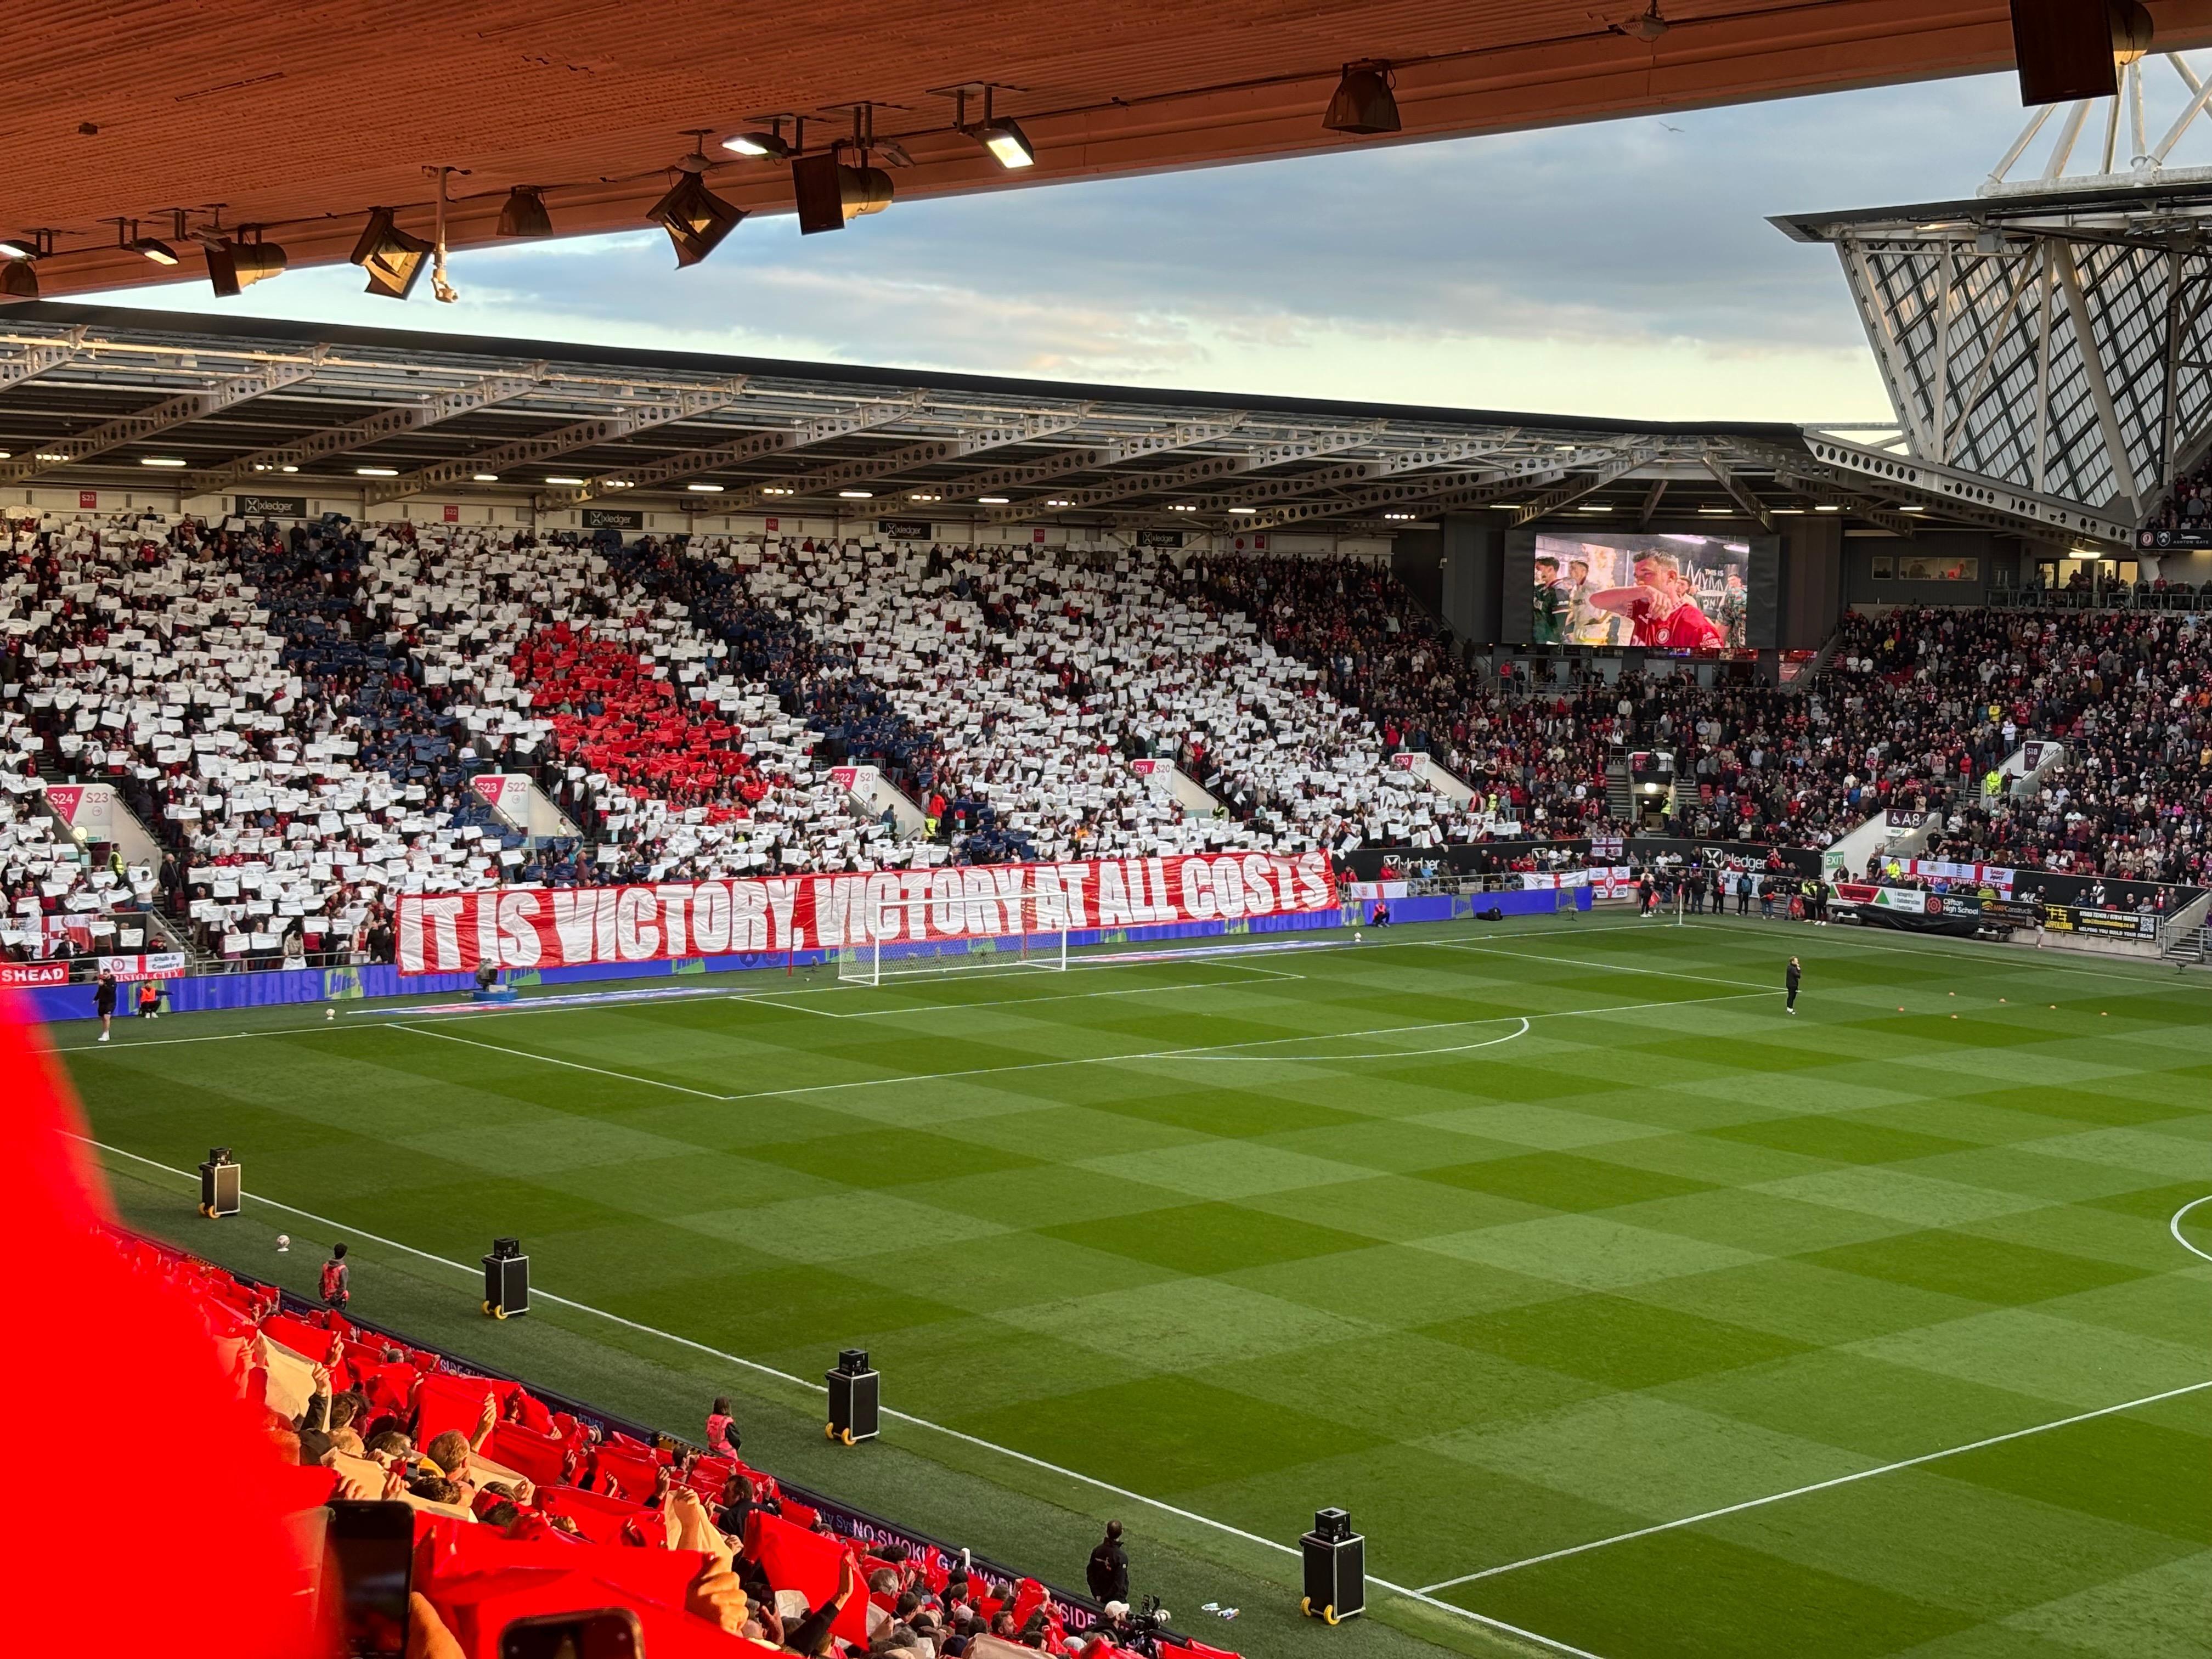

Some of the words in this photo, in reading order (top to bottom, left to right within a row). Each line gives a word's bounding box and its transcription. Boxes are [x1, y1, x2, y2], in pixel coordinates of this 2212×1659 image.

[259, 500, 293, 512] xledger
[603, 514, 632, 525] xledger
[897, 526, 922, 535] xledger
[1156, 764, 1170, 774] S20
[860, 772, 874, 782] S21
[507, 782, 527, 792] S22
[50, 793, 75, 805] S24
[86, 792, 109, 803] S23
[1901, 812, 1920, 826] A8
[1731, 853, 1767, 872] ledger
[1826, 855, 1843, 866] EXIT
[1943, 898, 1963, 906] Clifton
[400, 896, 465, 971] IT
[477, 891, 543, 966] IS
[814, 868, 1025, 946] VICTORY
[1035, 863, 1091, 931] AT
[1099, 857, 1178, 926] ALL
[1181, 852, 1329, 919] COSTS
[1943, 905, 1956, 913] High
[1957, 906, 1979, 915] School
[114, 973, 151, 982] RISTOL
[153, 969, 179, 980] CITY
[853, 1519, 874, 1539] NO
[877, 1529, 949, 1570] SMOKIG
